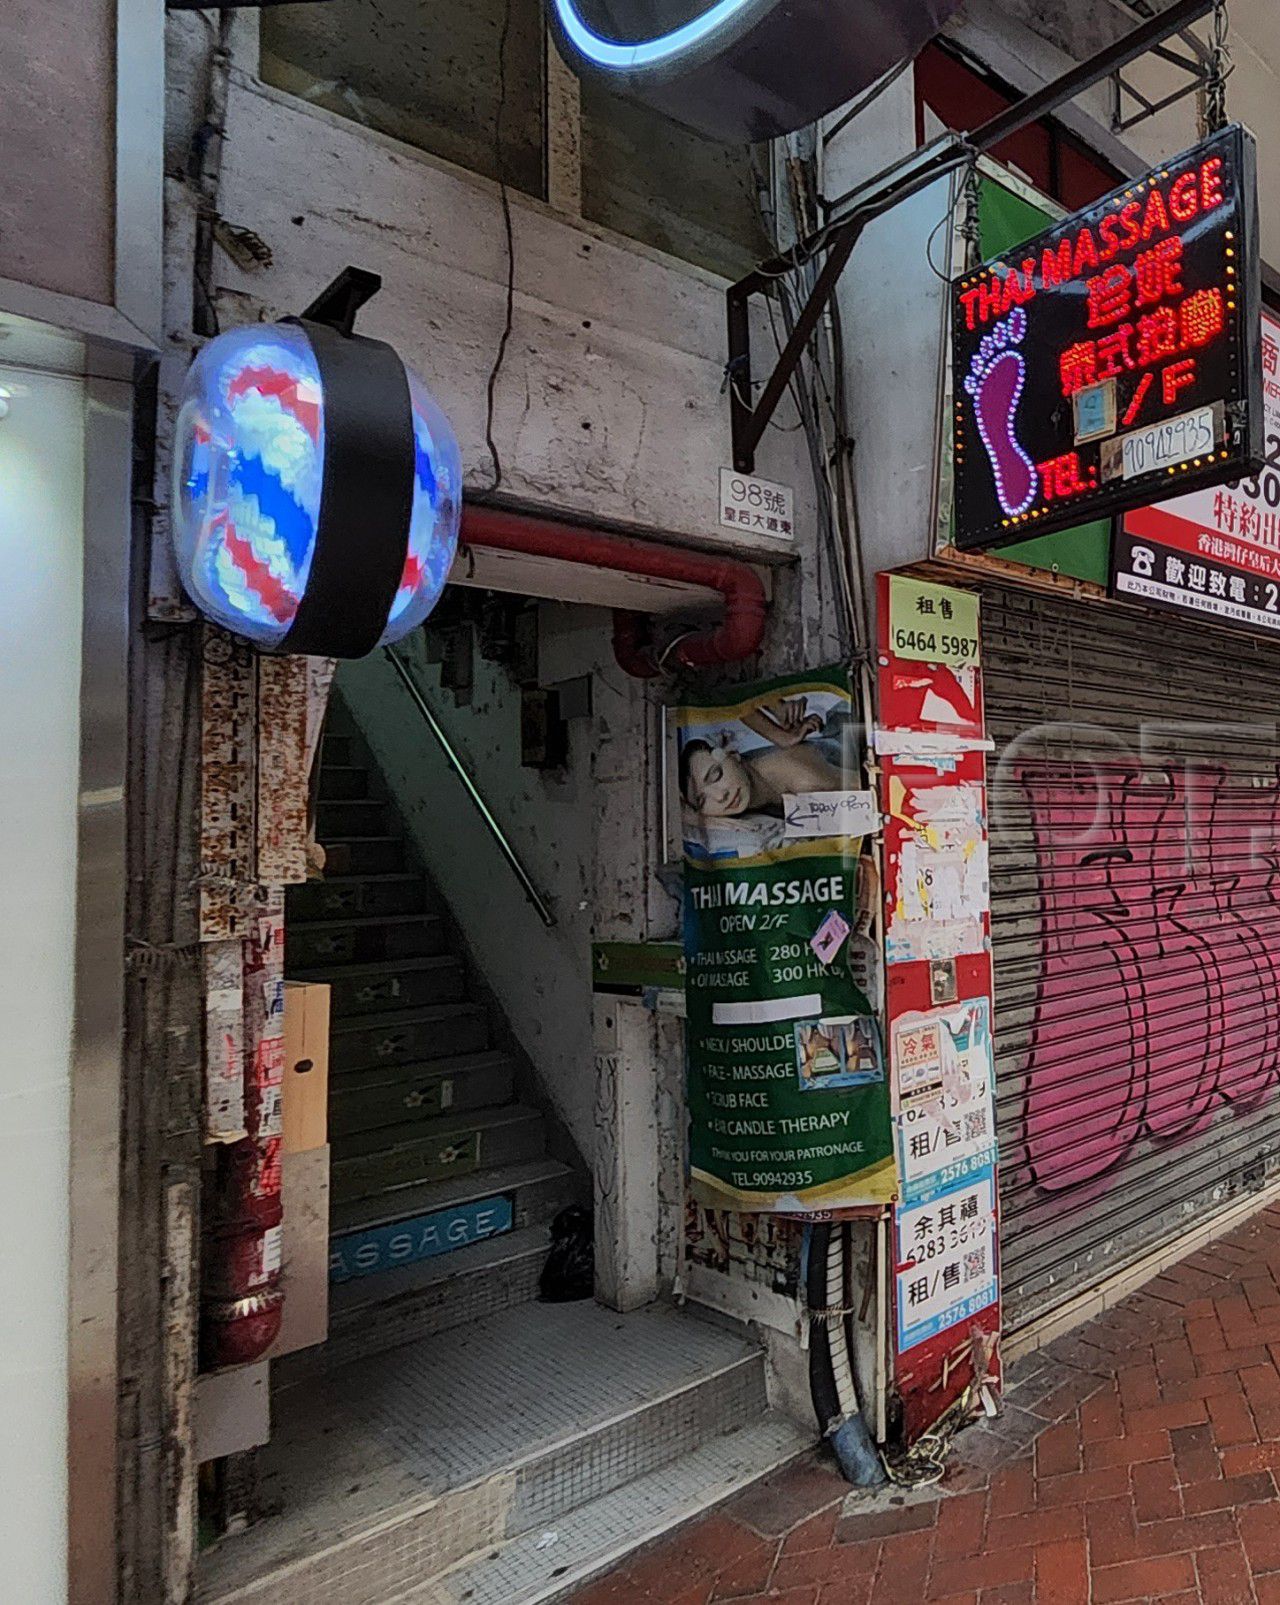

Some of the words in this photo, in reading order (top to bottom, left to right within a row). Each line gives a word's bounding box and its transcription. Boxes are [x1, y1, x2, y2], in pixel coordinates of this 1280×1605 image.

[959, 258, 1036, 330] THAI
[1042, 156, 1222, 291] MASSAGE
[731, 479, 786, 515] 98號
[915, 595, 954, 620] 租售
[896, 628, 937, 653] 6464
[941, 635, 978, 659] 5987
[725, 876, 844, 906] MASSAGE
[720, 914, 757, 934] OPEN
[758, 913, 789, 931] 2/F
[770, 944, 800, 961] 280
[772, 965, 803, 984] 300
[731, 1033, 795, 1052] SHOULDE
[732, 1062, 795, 1080] MASSAGE
[739, 1092, 769, 1108] FACE
[728, 1120, 776, 1136] CANDLE
[779, 1110, 851, 1135] THERAPY
[750, 1149, 769, 1162] FOR
[769, 1149, 796, 1162] YOUR
[797, 1141, 864, 1161] PATRONAGE
[941, 1161, 968, 1185] 2576
[914, 1193, 979, 1241] 余其禧
[330, 1208, 498, 1272] ASSAGE
[908, 1260, 961, 1308] 租/售
[938, 1305, 967, 1331] 2576
[969, 1290, 994, 1313] 8081
